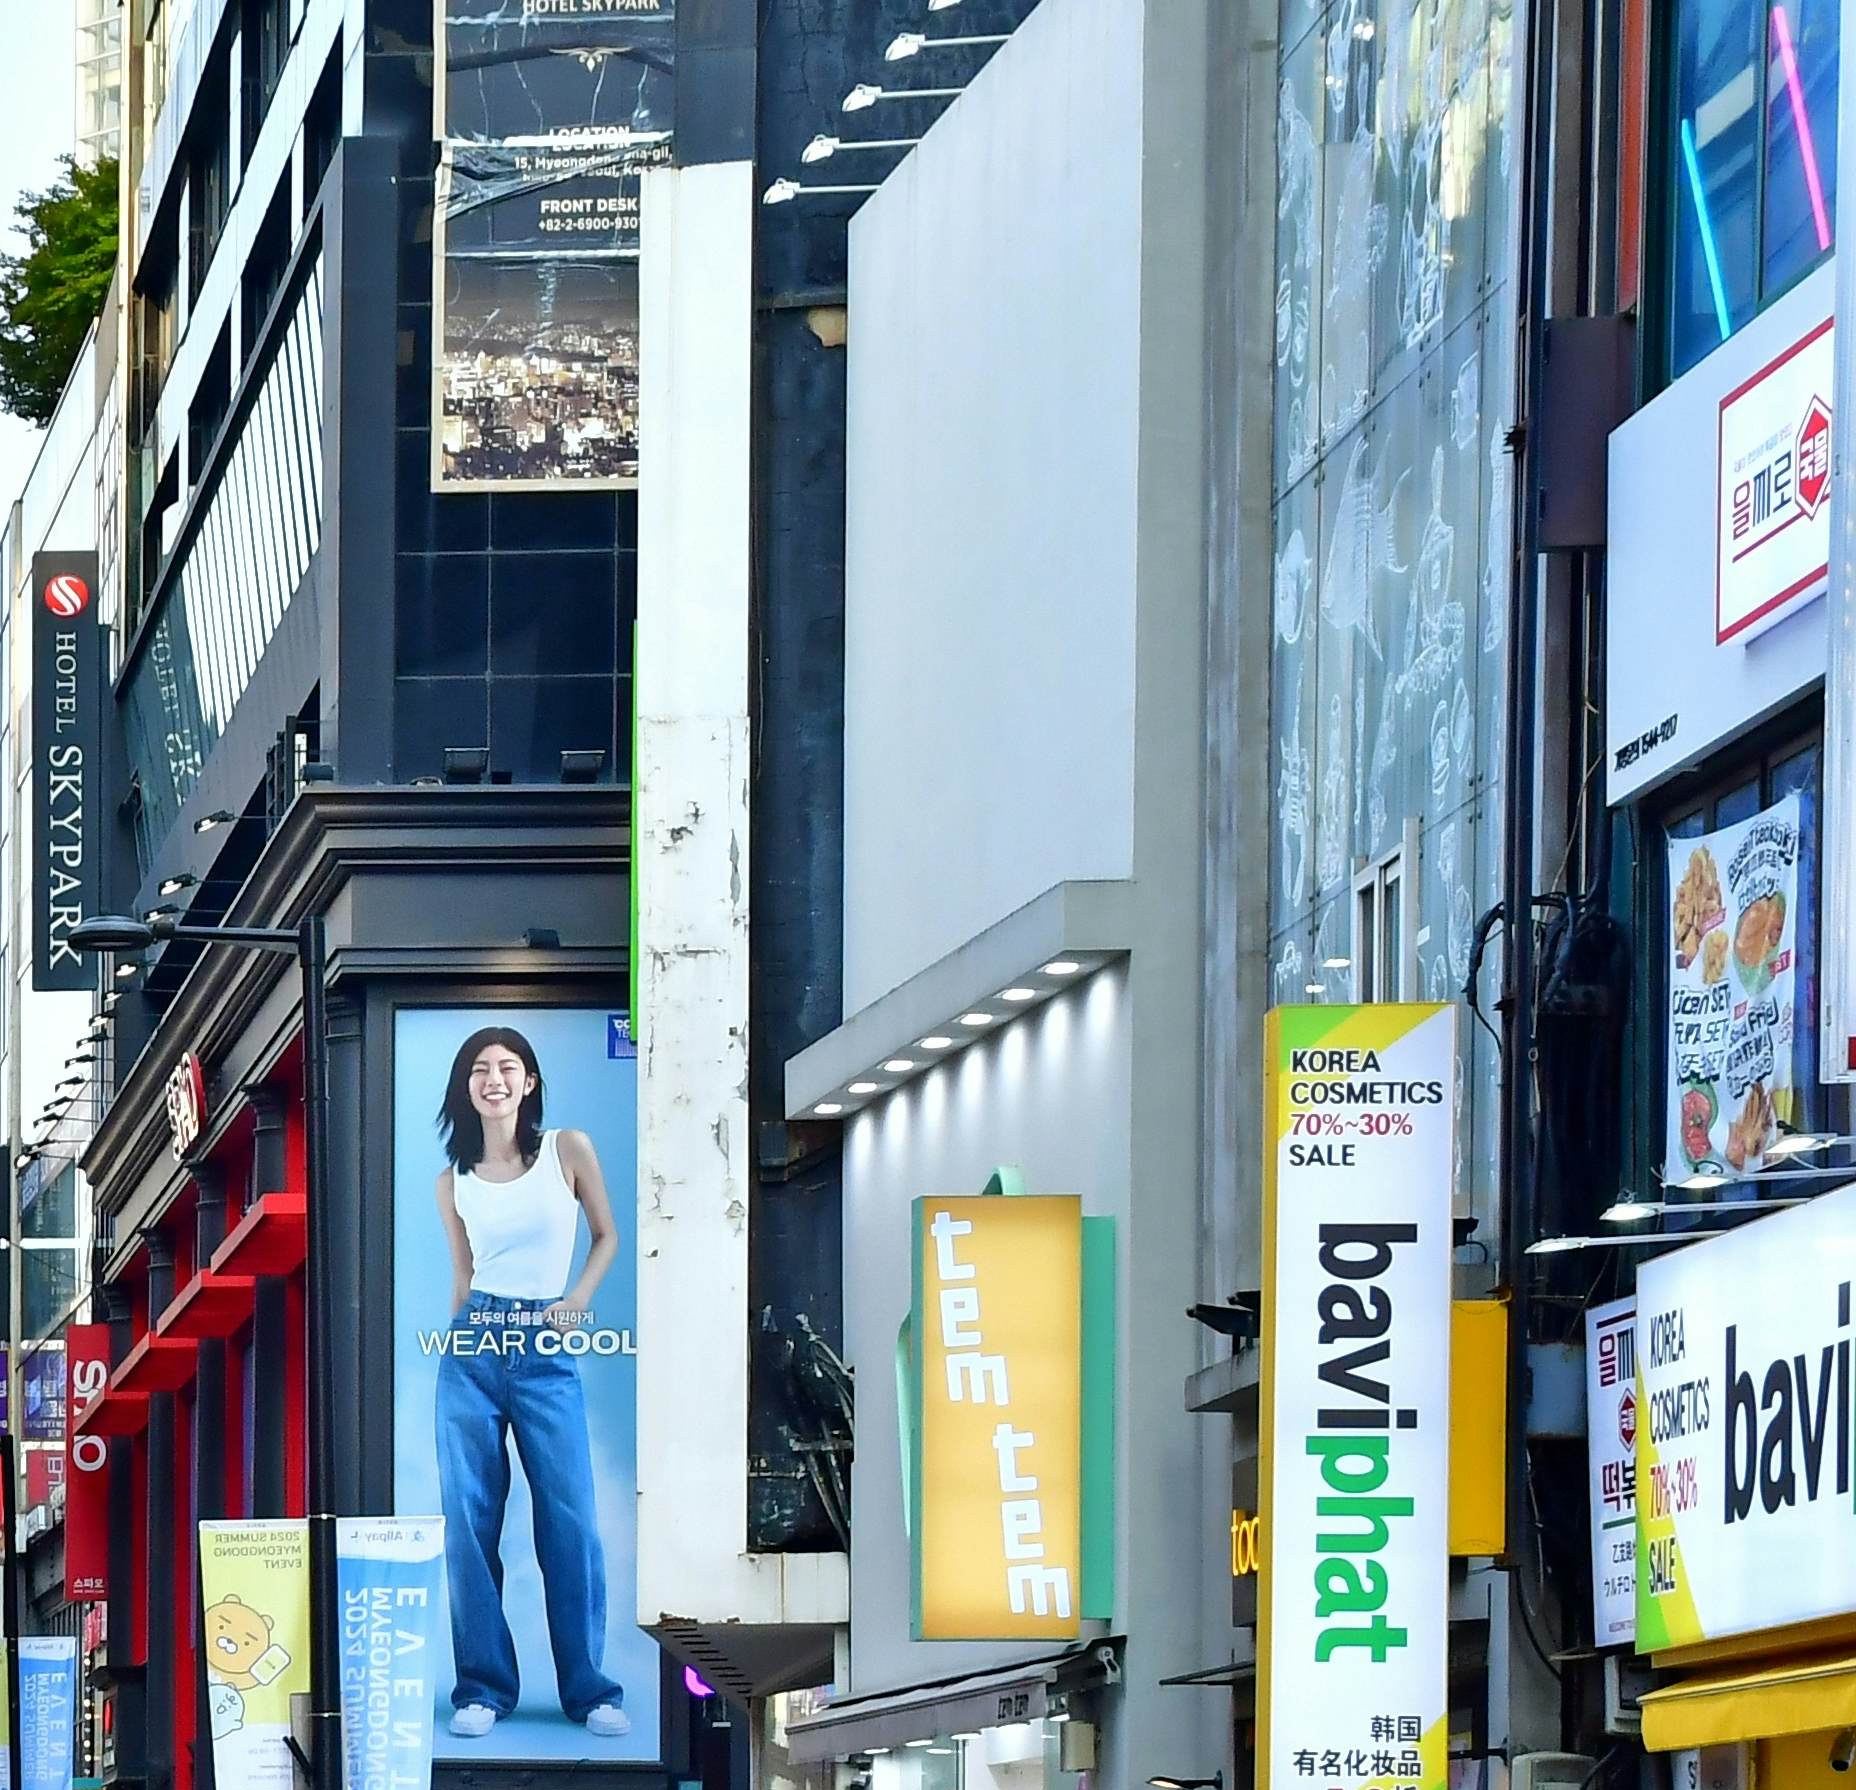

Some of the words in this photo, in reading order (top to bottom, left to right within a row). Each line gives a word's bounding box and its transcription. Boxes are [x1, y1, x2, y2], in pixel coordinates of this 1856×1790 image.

[540, 199, 594, 214] FRONT
[597, 197, 638, 212] DESK
[54, 631, 78, 735] HOTEL
[48, 744, 85, 973] SKYPARK
[1291, 1049, 1381, 1074] KOREA
[1290, 1080, 1444, 1106] COSMETICS
[1290, 1112, 1414, 1137] 70%~30%
[1289, 1143, 1356, 1168] SALE
[468, 1310, 505, 1326] 모두의
[546, 1310, 595, 1326] 시원하게
[416, 1329, 527, 1356] WEAR
[534, 1329, 638, 1356] COOL
[1650, 1307, 1686, 1370] KOREA
[930, 1211, 1009, 1406] tem
[992, 1423, 1070, 1618] tem
[1649, 1376, 1711, 1445] COSMETICS
[1724, 1280, 1856, 1524] bavi
[1304, 1222, 1419, 1665] baviphat
[1648, 1535, 1677, 1596] SALE
[73, 1578, 105, 1589] 스파오
[1368, 1716, 1423, 1744] 韩国
[1292, 1749, 1423, 1777] 有名化妆品
